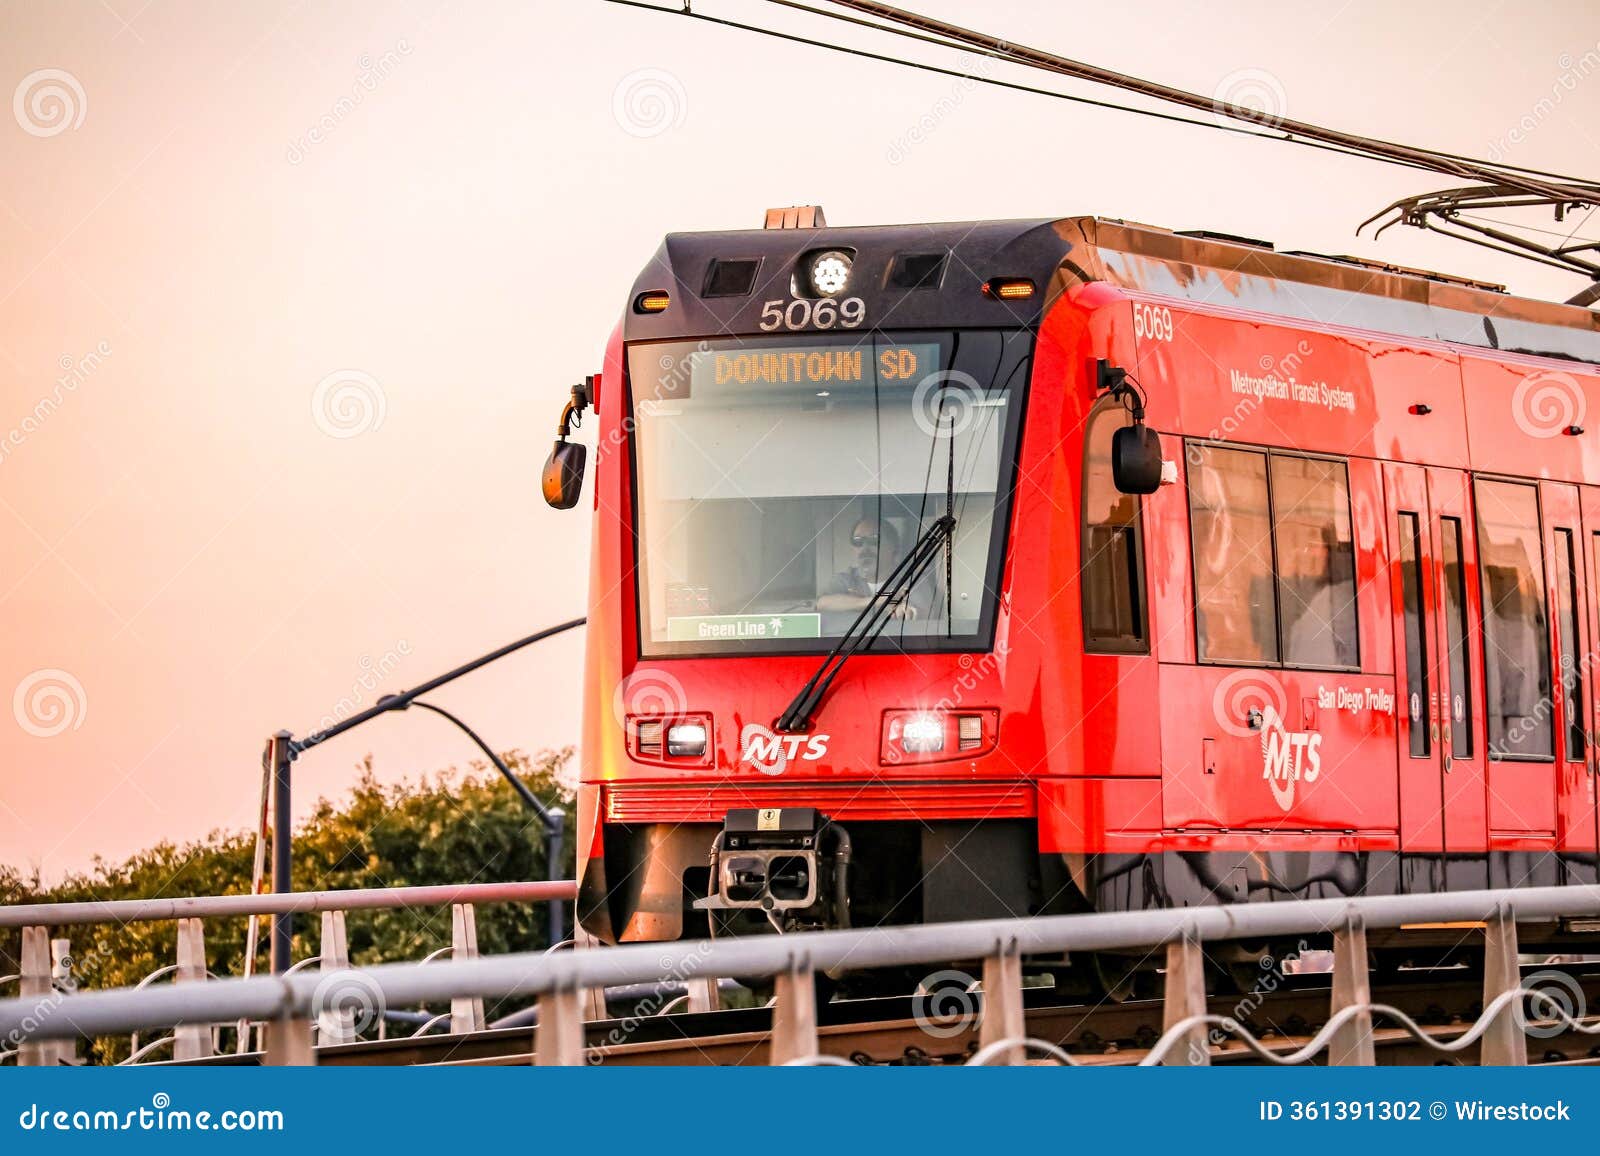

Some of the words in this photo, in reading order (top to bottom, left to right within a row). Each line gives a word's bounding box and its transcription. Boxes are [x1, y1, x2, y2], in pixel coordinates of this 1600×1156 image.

[759, 297, 866, 331] 5069
[1134, 303, 1173, 342] 5069
[716, 351, 861, 384] DOWNTOWN
[880, 349, 917, 379] SD
[1230, 368, 1290, 403] Metropolitan
[1289, 377, 1320, 404] Transit
[1321, 382, 1355, 411] System
[699, 622, 736, 637] Green
[737, 621, 766, 636] Line
[1318, 685, 1336, 709] San
[1338, 686, 1363, 714] Diego
[1365, 687, 1395, 715] Trolley
[742, 734, 831, 761] MTS
[1262, 731, 1323, 782] MTS
